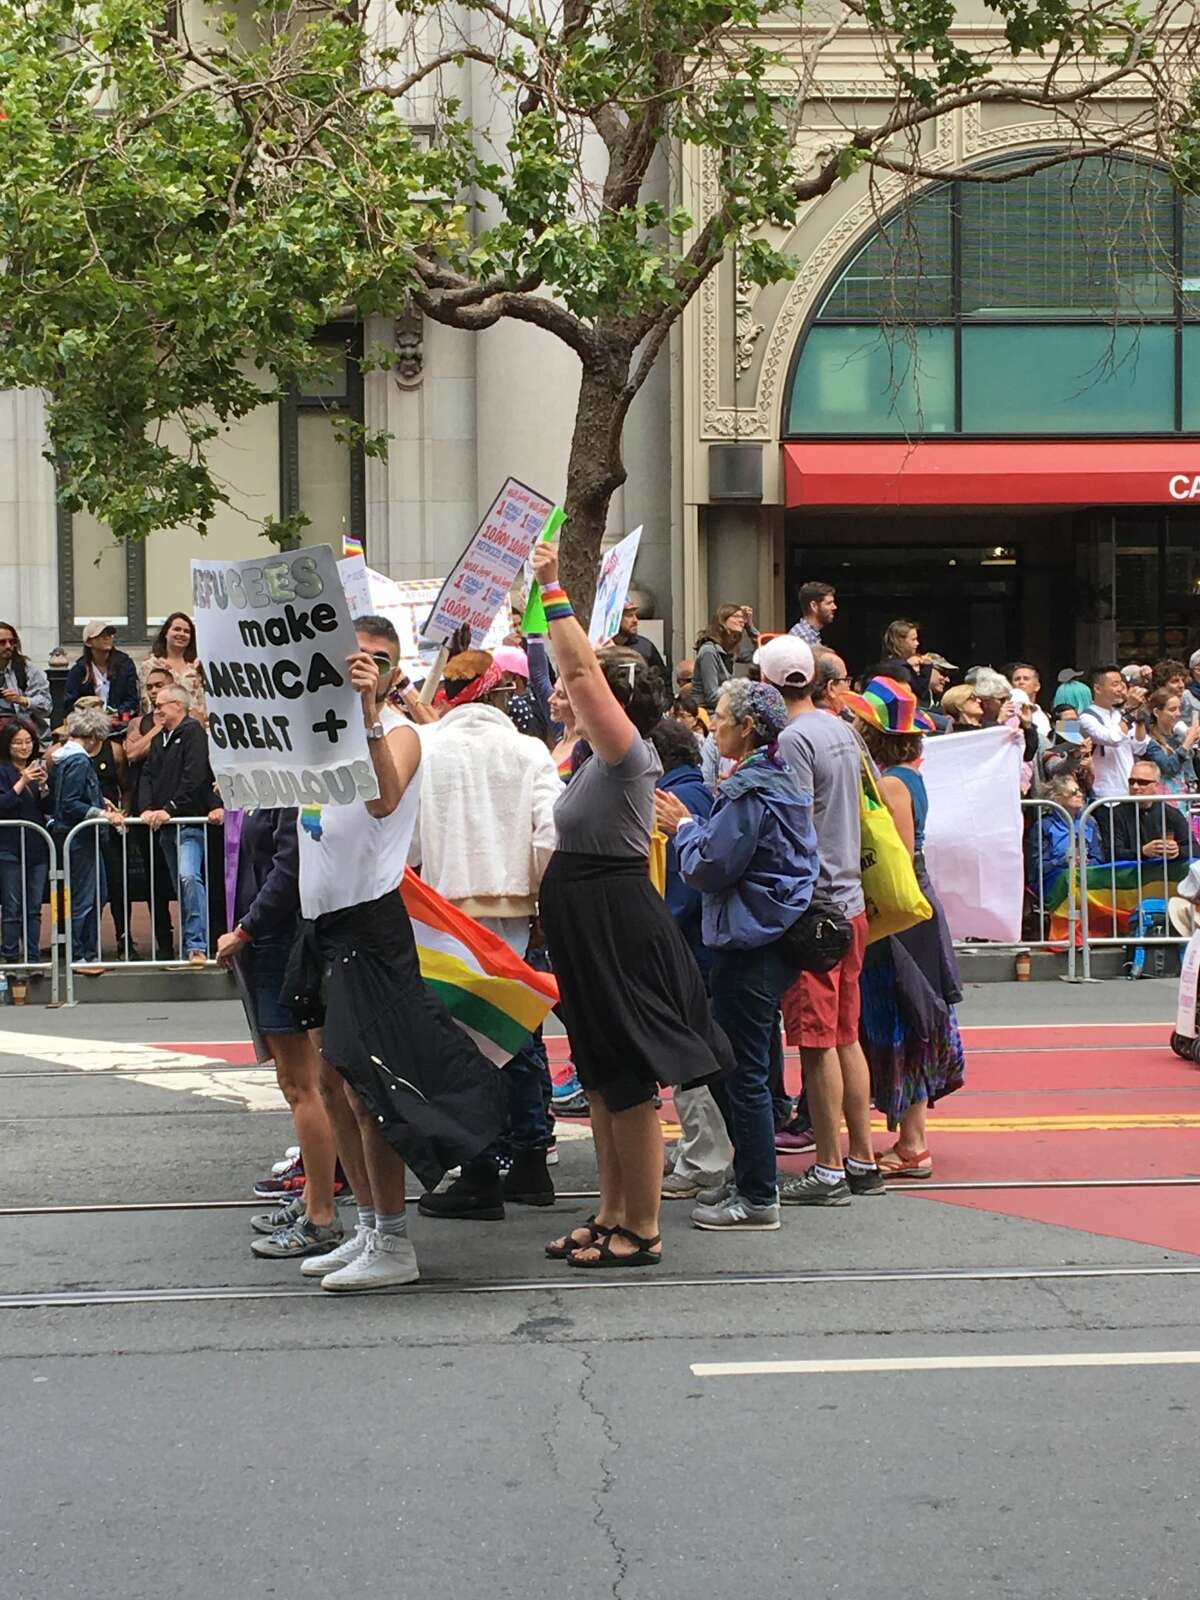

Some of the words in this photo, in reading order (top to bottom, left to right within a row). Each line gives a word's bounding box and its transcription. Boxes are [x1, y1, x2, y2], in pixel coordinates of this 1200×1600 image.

[238, 603, 338, 647] make
[198, 652, 343, 699] AMERICA
[209, 712, 292, 751] GREAT
[217, 760, 377, 809] FABULOUS
[729, 1207, 748, 1221] N
